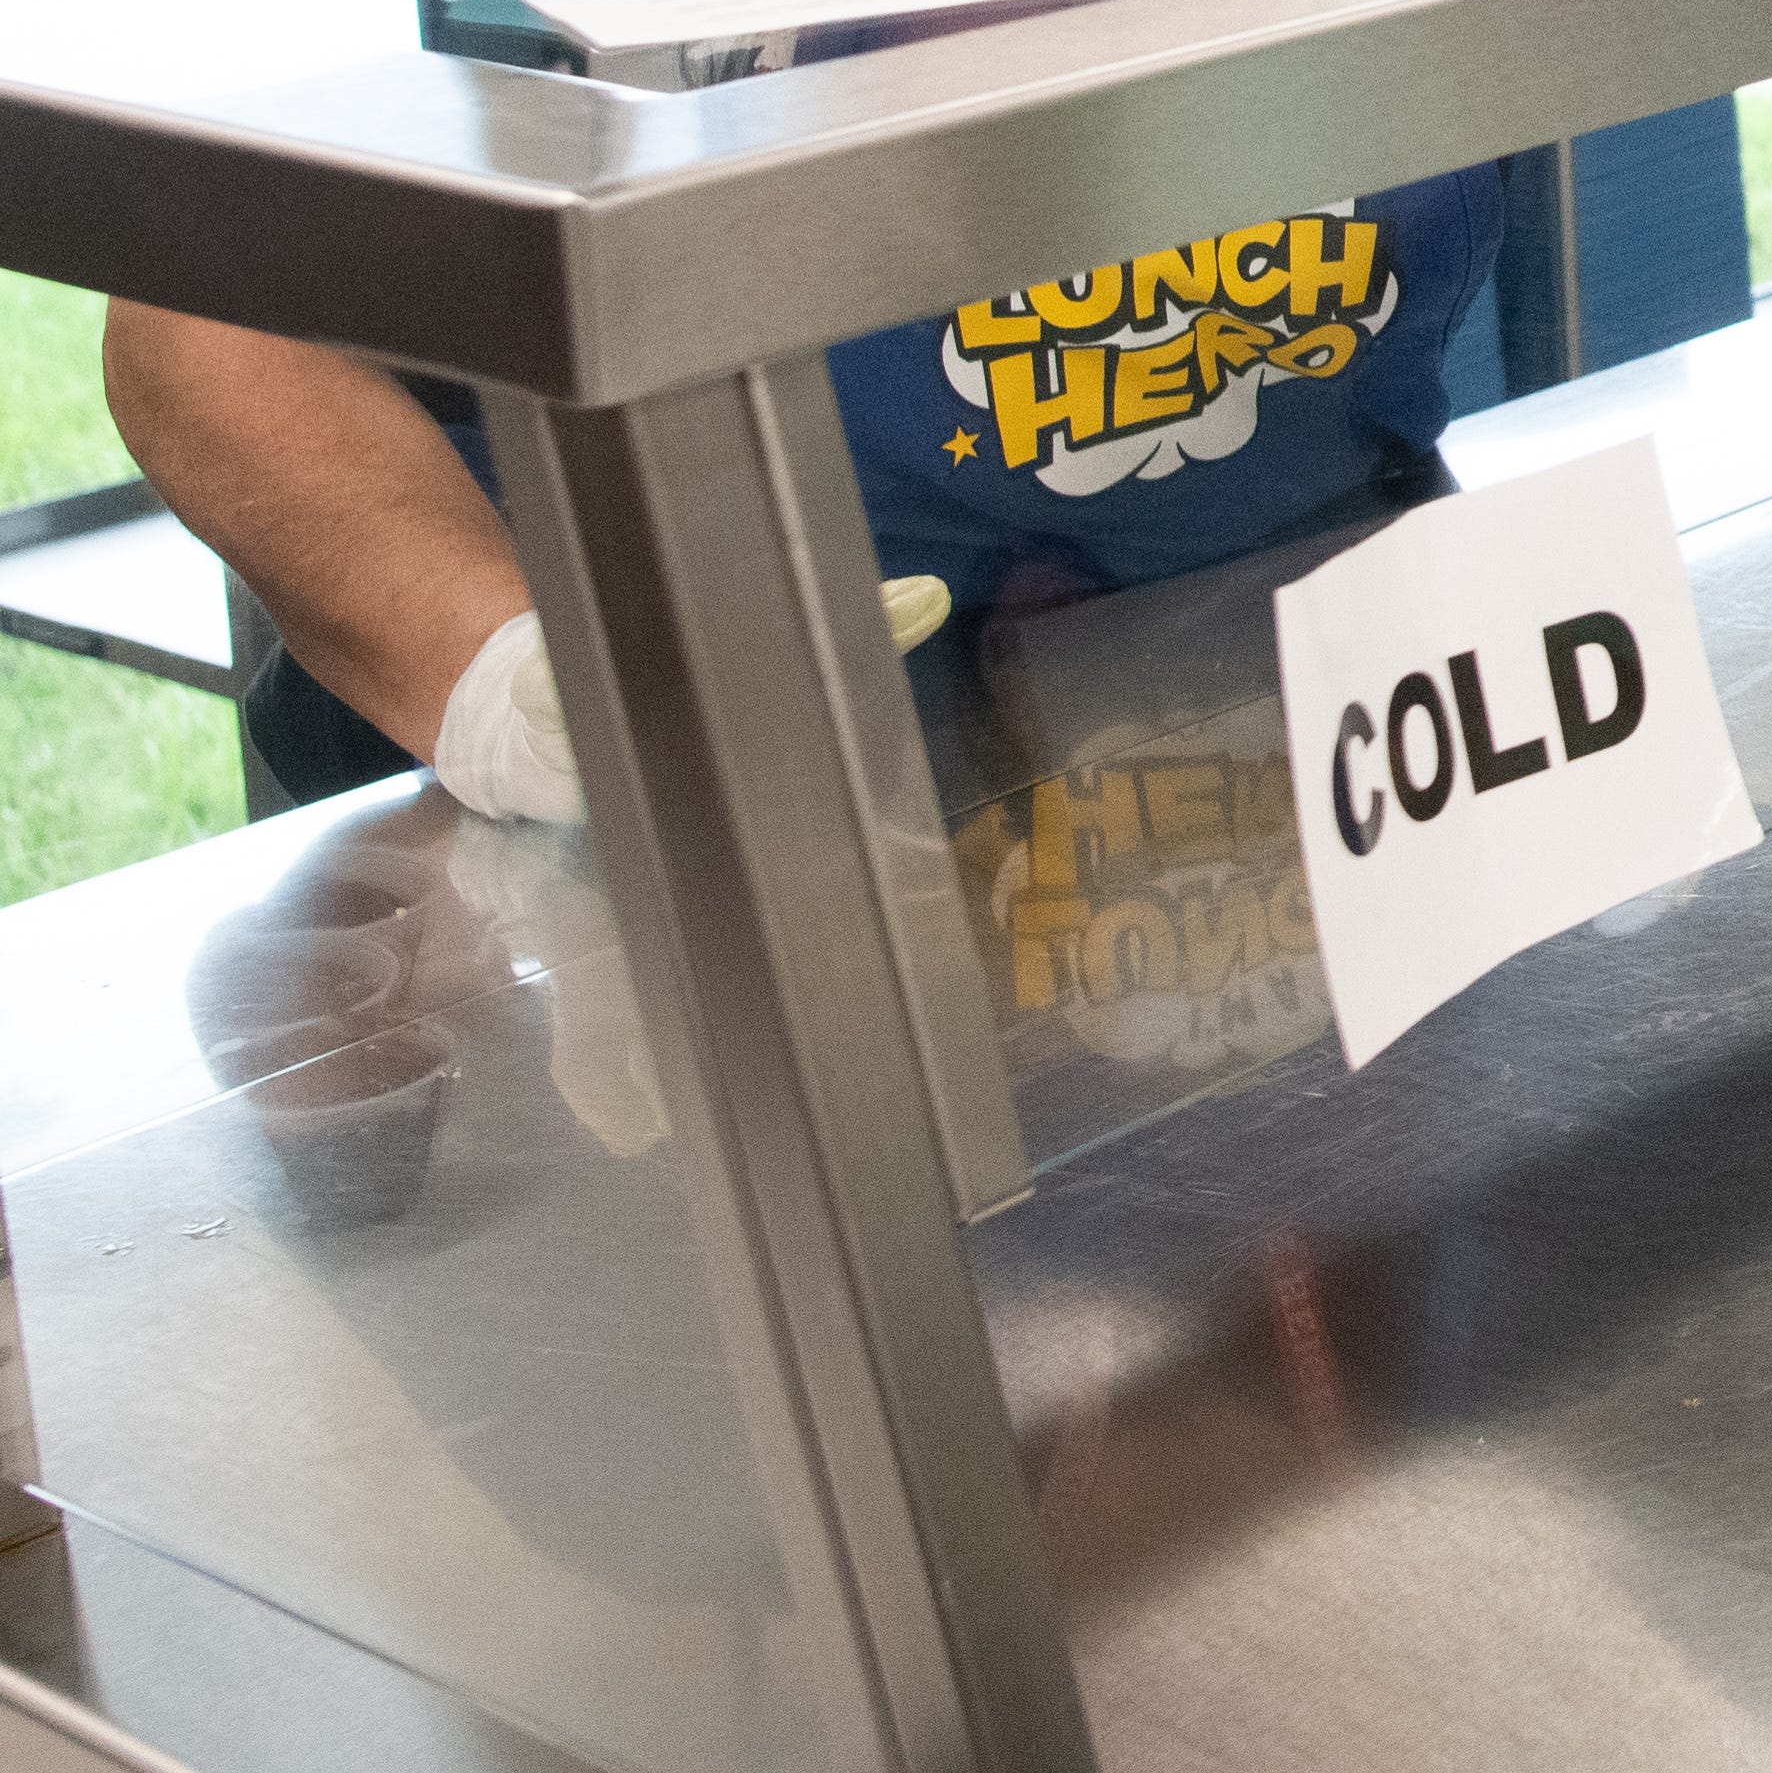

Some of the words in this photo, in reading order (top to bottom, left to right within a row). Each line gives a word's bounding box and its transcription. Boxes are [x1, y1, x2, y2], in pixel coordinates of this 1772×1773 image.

[957, 218, 1378, 349] LUNCH
[989, 311, 1358, 469] HERO
[1332, 610, 1647, 858] COLD
